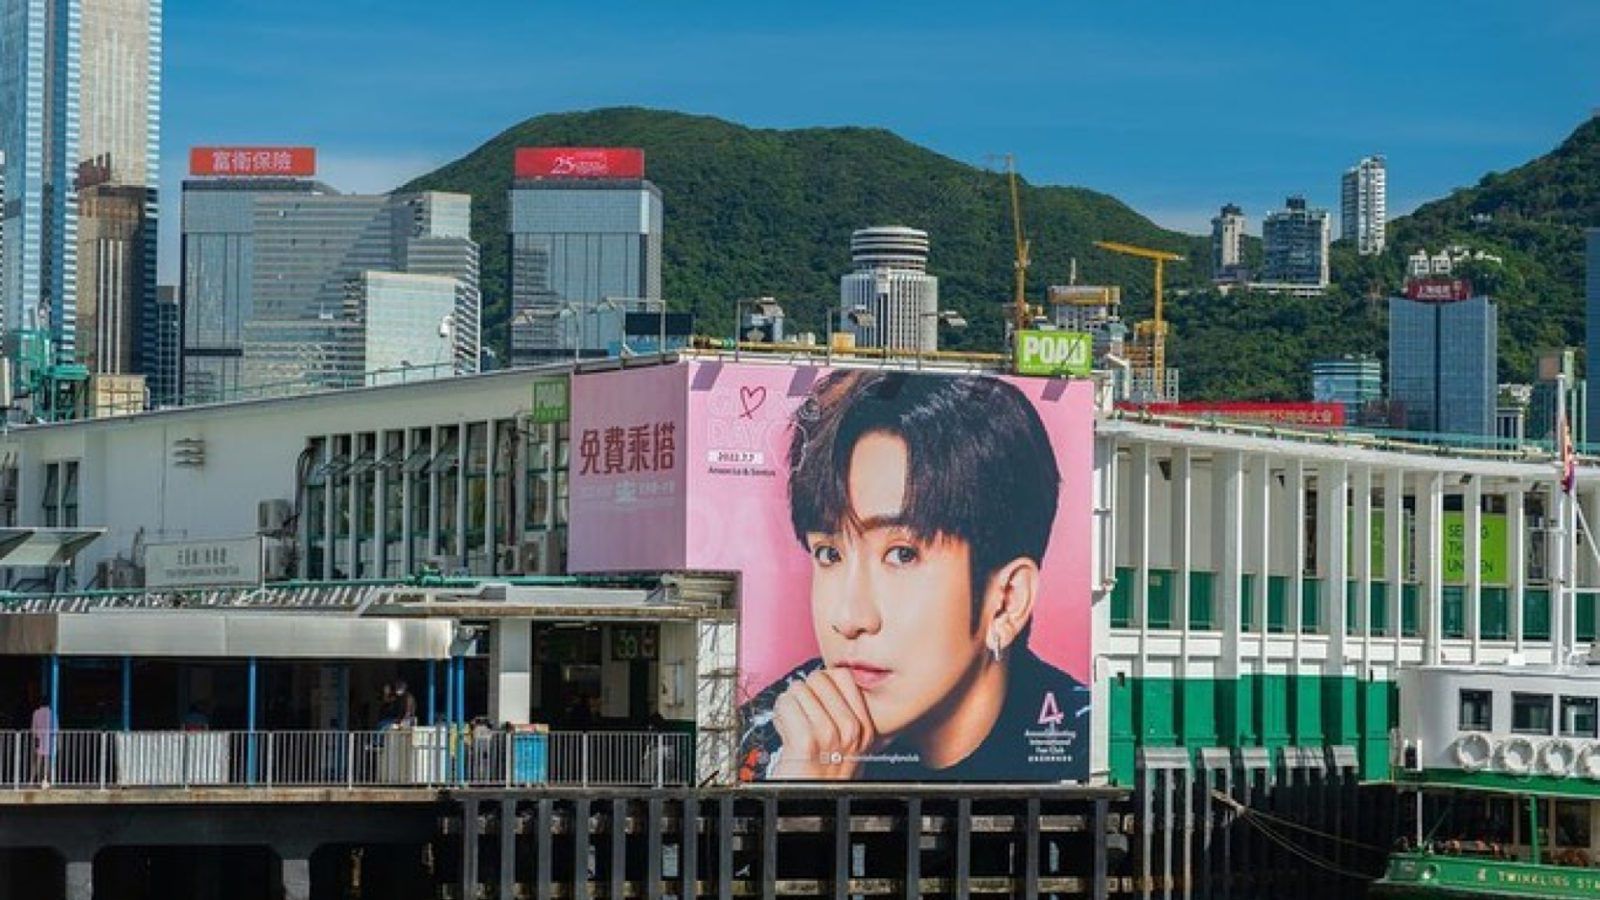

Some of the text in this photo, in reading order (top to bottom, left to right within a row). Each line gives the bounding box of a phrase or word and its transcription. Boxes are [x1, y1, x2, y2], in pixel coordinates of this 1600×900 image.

[1024, 336, 1086, 365] POAD
[579, 420, 675, 476] 免費乘搭
